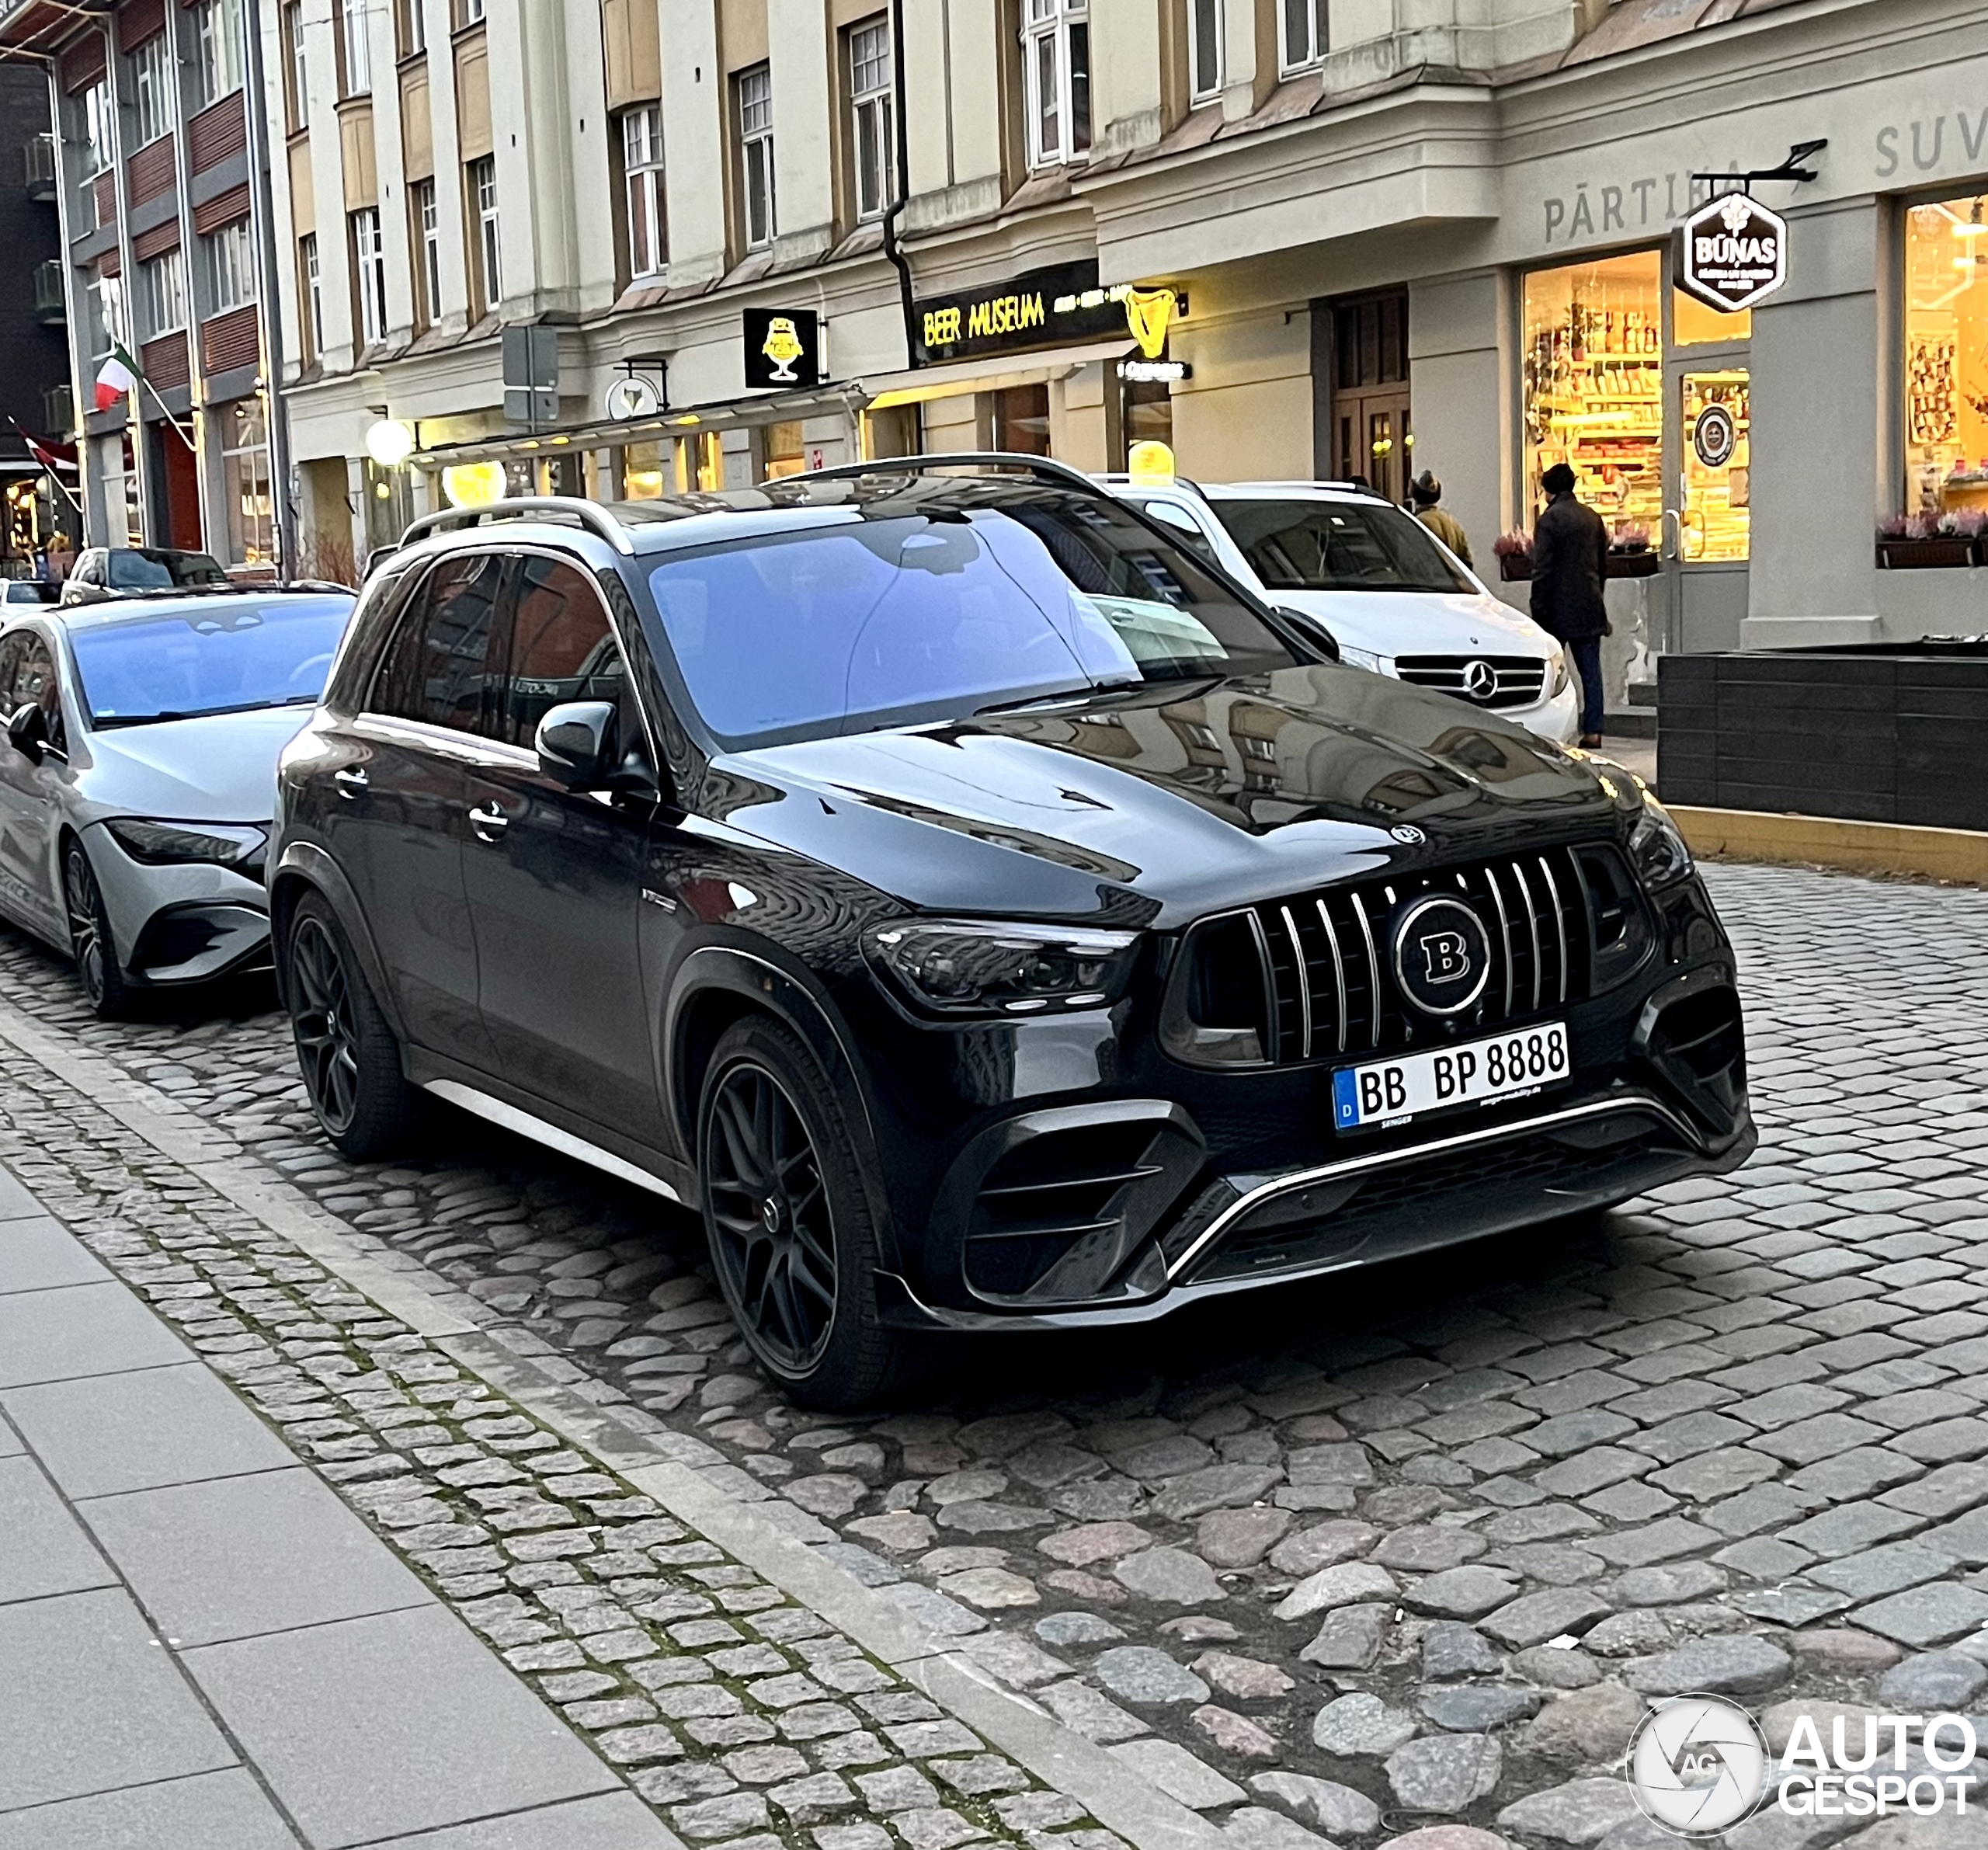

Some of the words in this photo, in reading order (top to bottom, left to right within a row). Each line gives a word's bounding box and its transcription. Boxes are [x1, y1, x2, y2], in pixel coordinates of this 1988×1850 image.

[1875, 107, 1988, 177] SUV
[1695, 233, 1776, 269] BŪŅAS
[923, 306, 961, 347] BEER
[968, 291, 1044, 339] MUSEUM
[1420, 931, 1471, 985] B
[1360, 1066, 1406, 1116] BB
[1434, 1050, 1476, 1100] BP
[1486, 1029, 1565, 1087] 8888
[1342, 1104, 1353, 1118] D
